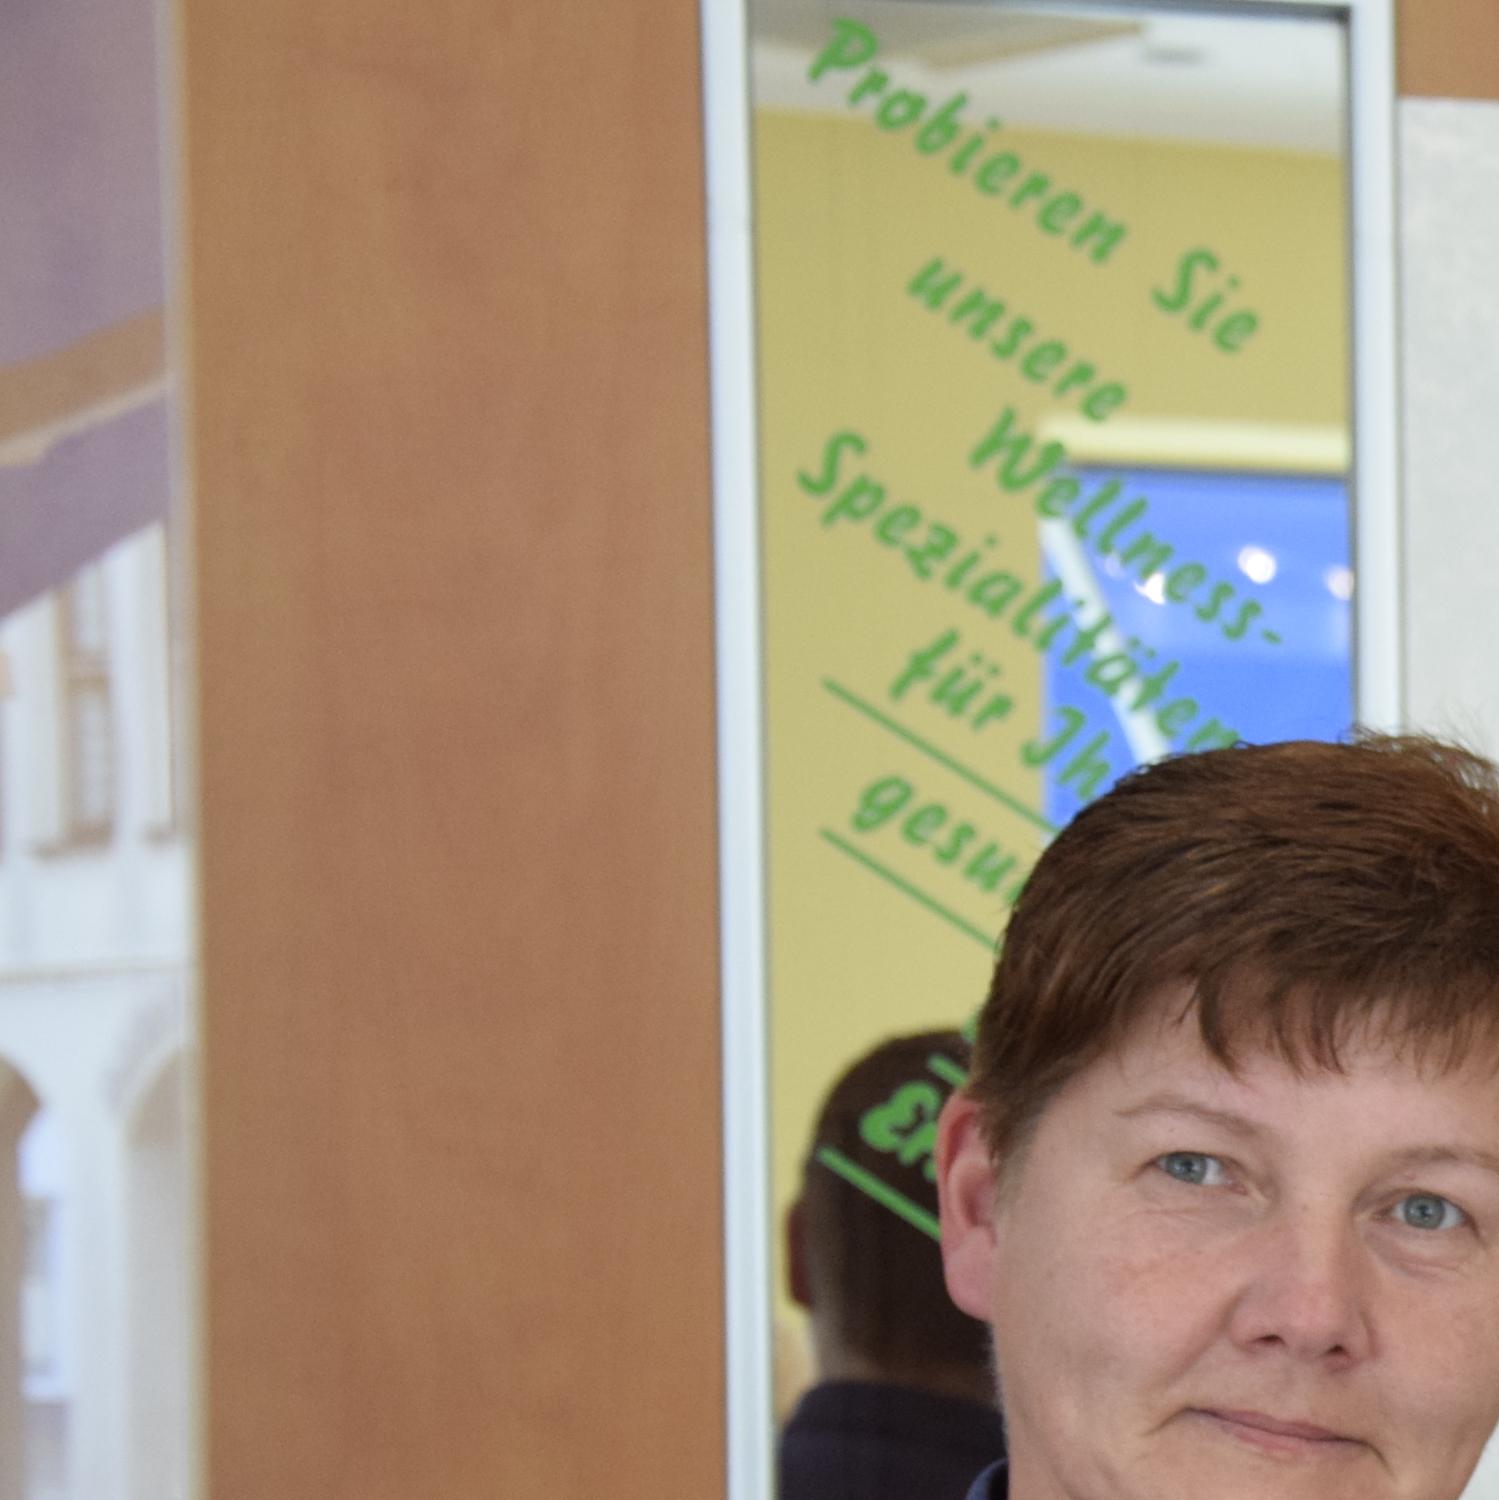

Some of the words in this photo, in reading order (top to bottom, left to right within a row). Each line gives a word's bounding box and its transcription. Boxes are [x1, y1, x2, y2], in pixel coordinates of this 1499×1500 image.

[807, 16, 1127, 264] Probieren
[1151, 246, 1260, 354] Sie
[906, 256, 1128, 422] unsere
[969, 406, 1283, 645] Wellness-
[889, 628, 1014, 731] für
[852, 773, 1029, 905] gesu
